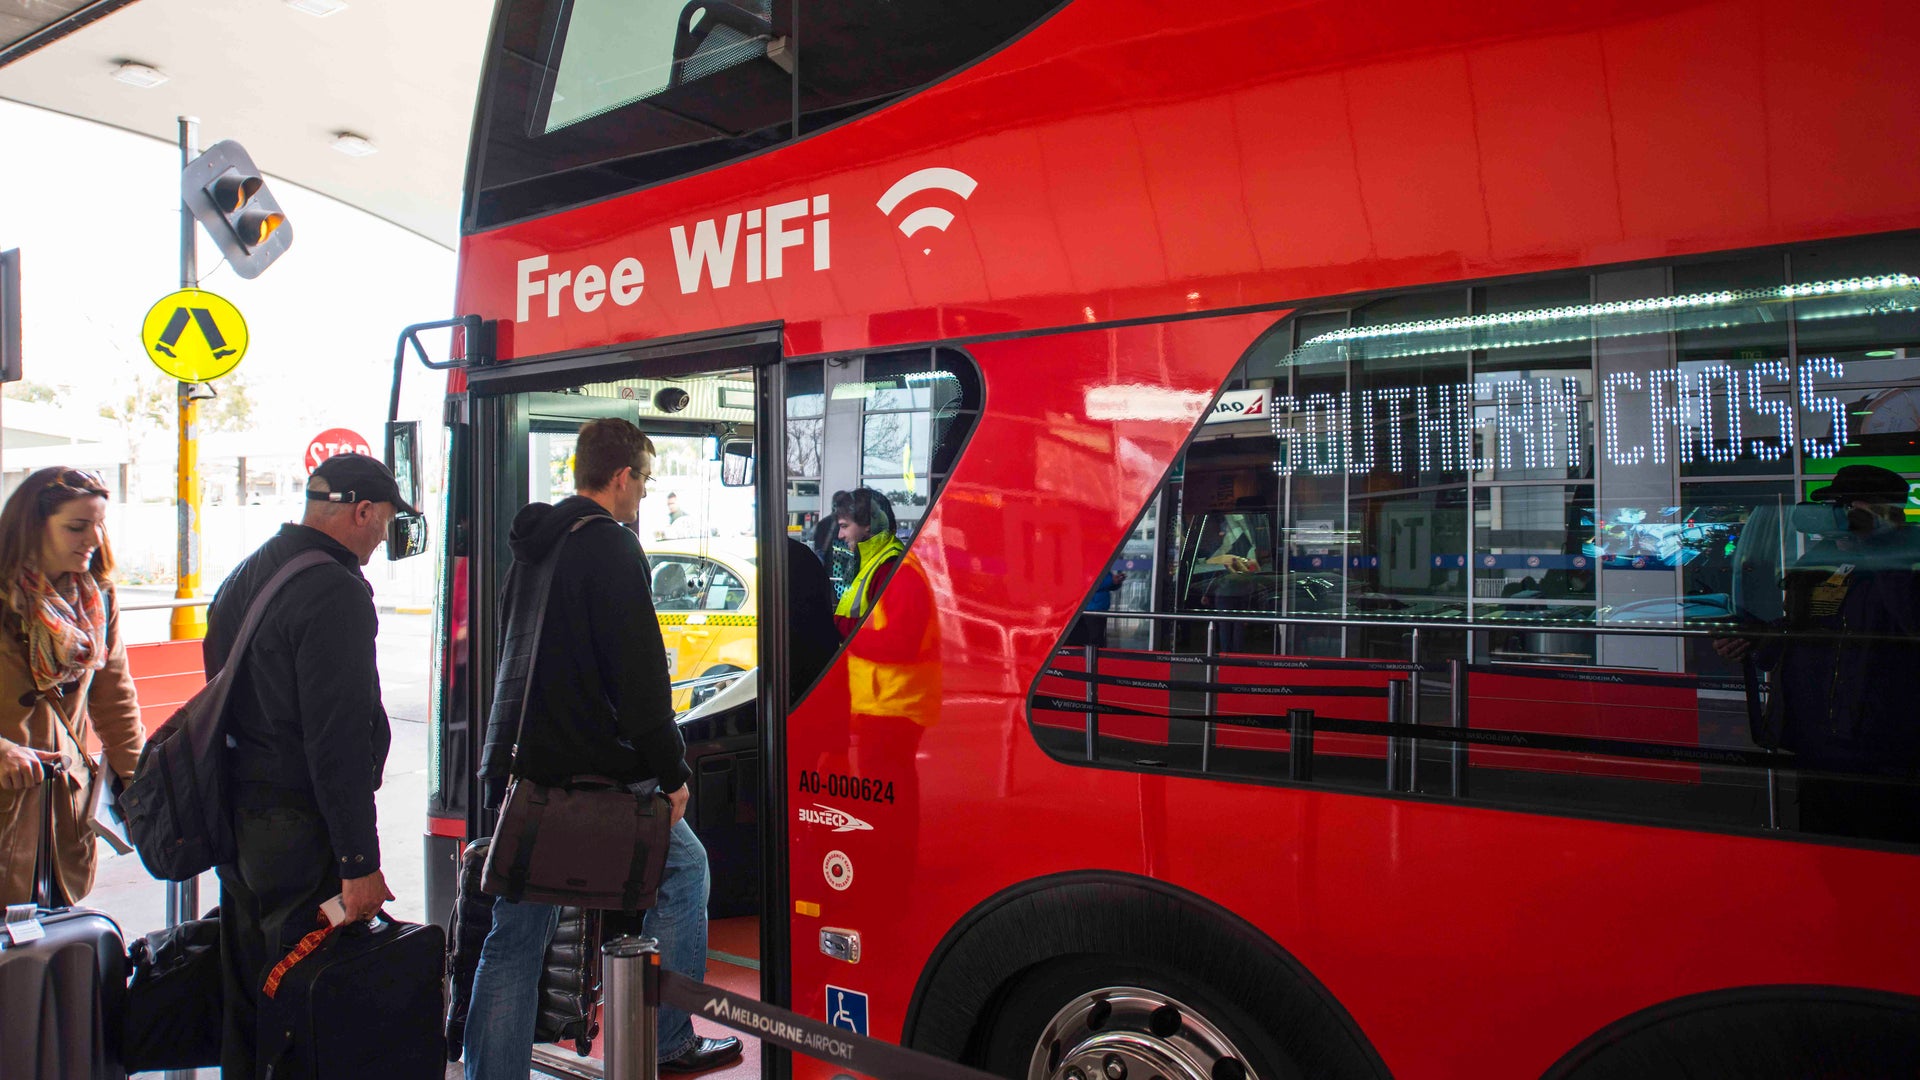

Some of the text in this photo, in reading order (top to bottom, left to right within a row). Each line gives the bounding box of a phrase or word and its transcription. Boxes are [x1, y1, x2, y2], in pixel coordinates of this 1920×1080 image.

[516, 193, 830, 323] Free WiFi
[1271, 356, 1848, 475] SOUTHERN CROSS
[730, 1005, 855, 1060] MELBOURNE AIRPORT
